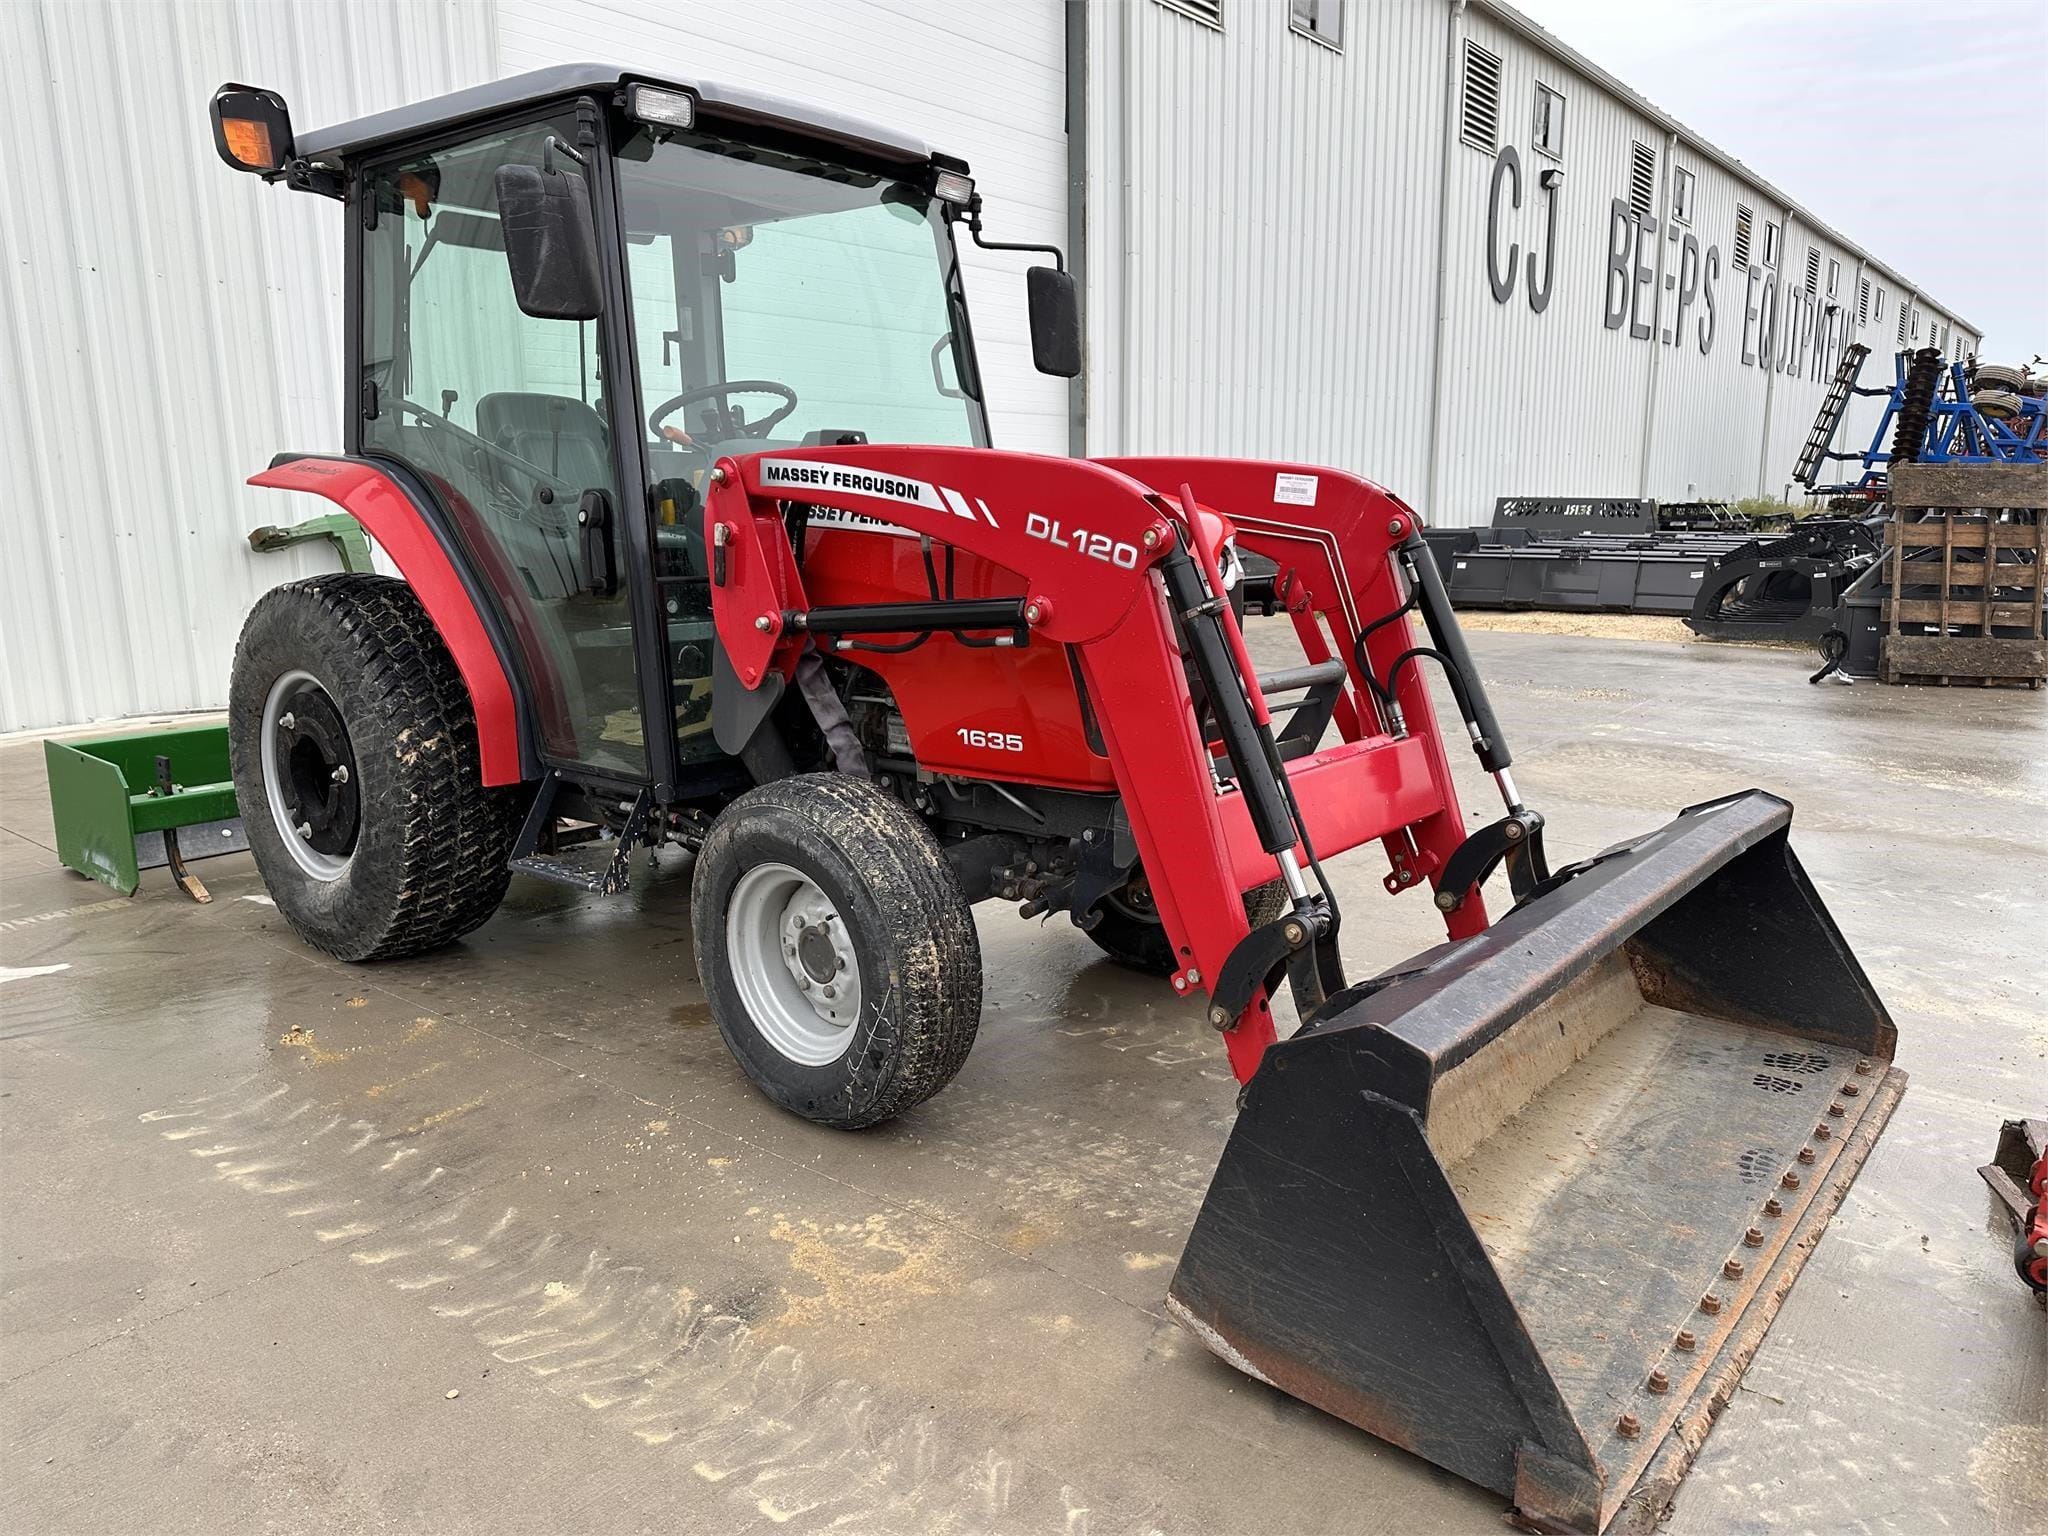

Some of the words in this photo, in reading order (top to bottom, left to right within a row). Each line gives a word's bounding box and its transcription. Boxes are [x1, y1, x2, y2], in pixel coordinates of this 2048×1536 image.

[1487, 144, 1559, 314] CJ
[1604, 197, 1720, 356] BEEPS
[767, 466, 829, 485] MASSEY
[833, 472, 920, 501] FERGUSON
[809, 504, 848, 522] SSEY
[1025, 512, 1138, 570] DL120
[956, 728, 1024, 752] 1635
